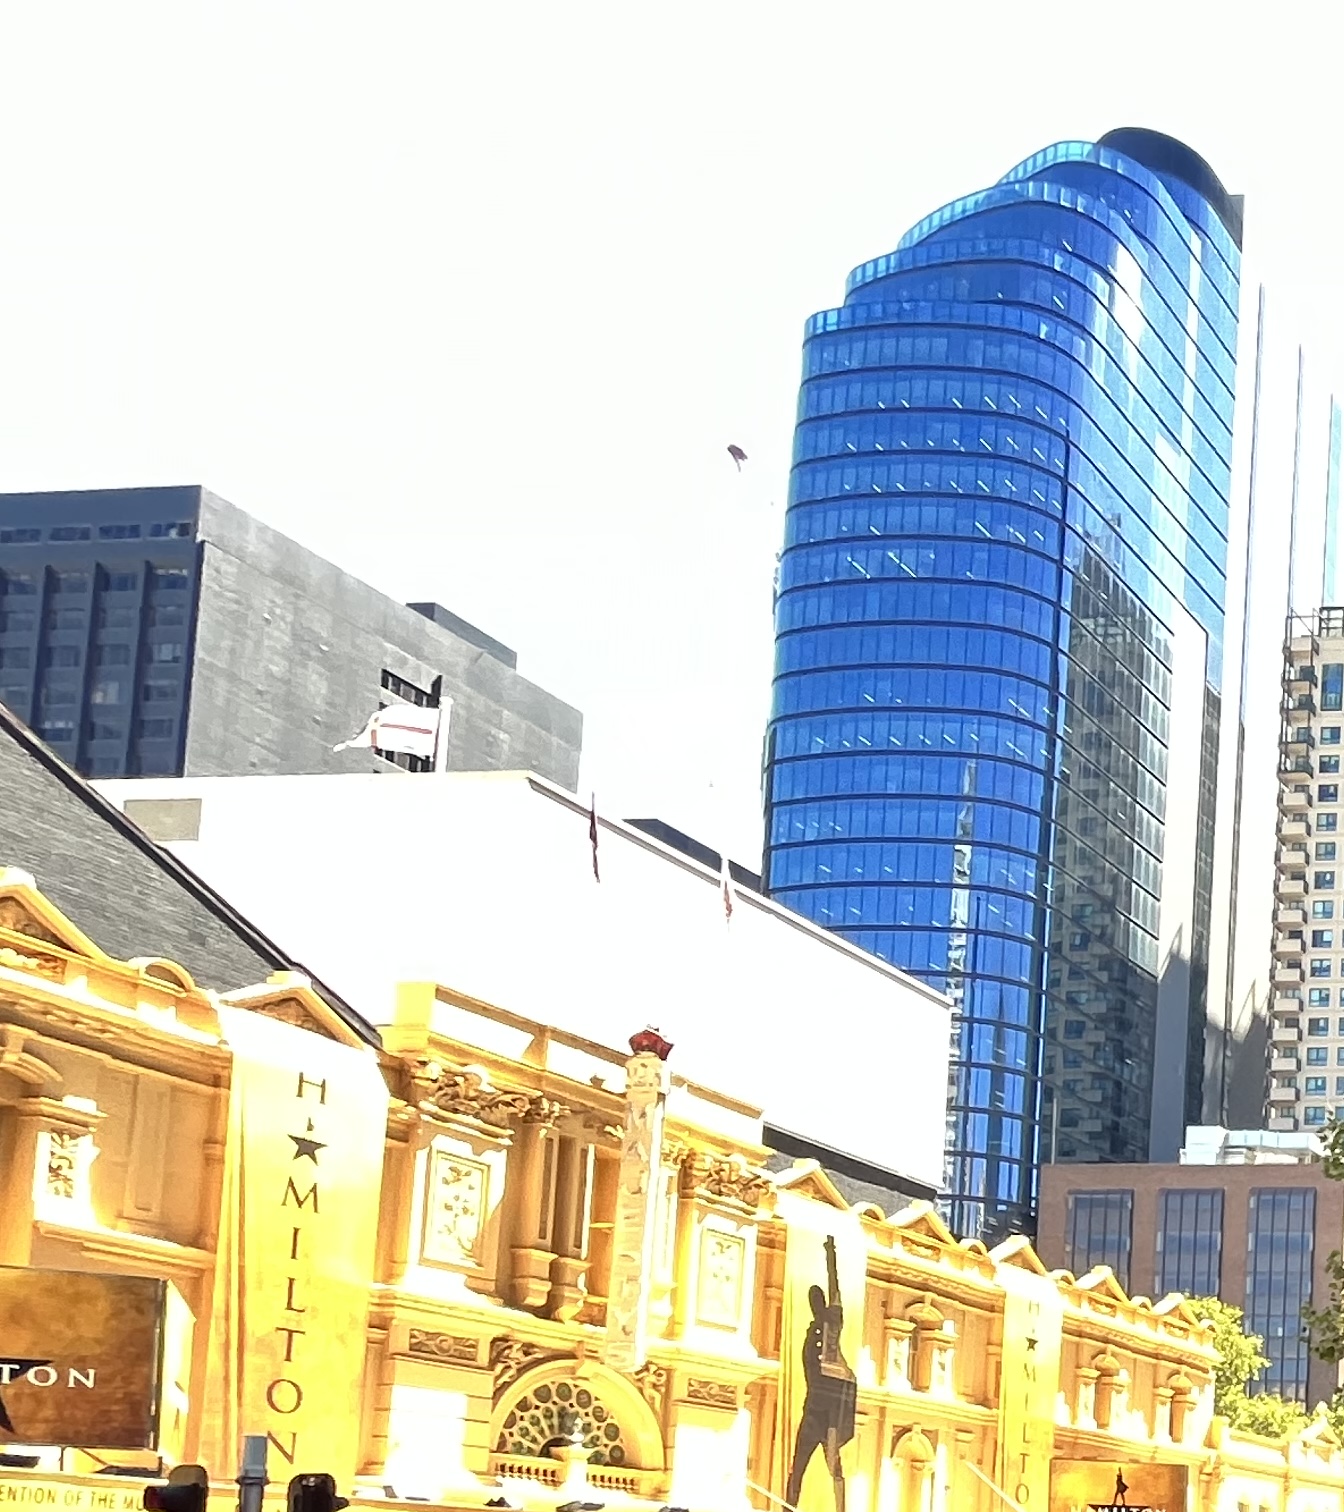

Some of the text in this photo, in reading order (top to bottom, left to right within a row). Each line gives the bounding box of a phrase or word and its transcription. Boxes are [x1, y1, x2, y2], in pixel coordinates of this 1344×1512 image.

[0, 1363, 97, 1389] TON
[64, 1489, 84, 1507] OF
[90, 1490, 116, 1510] THE
